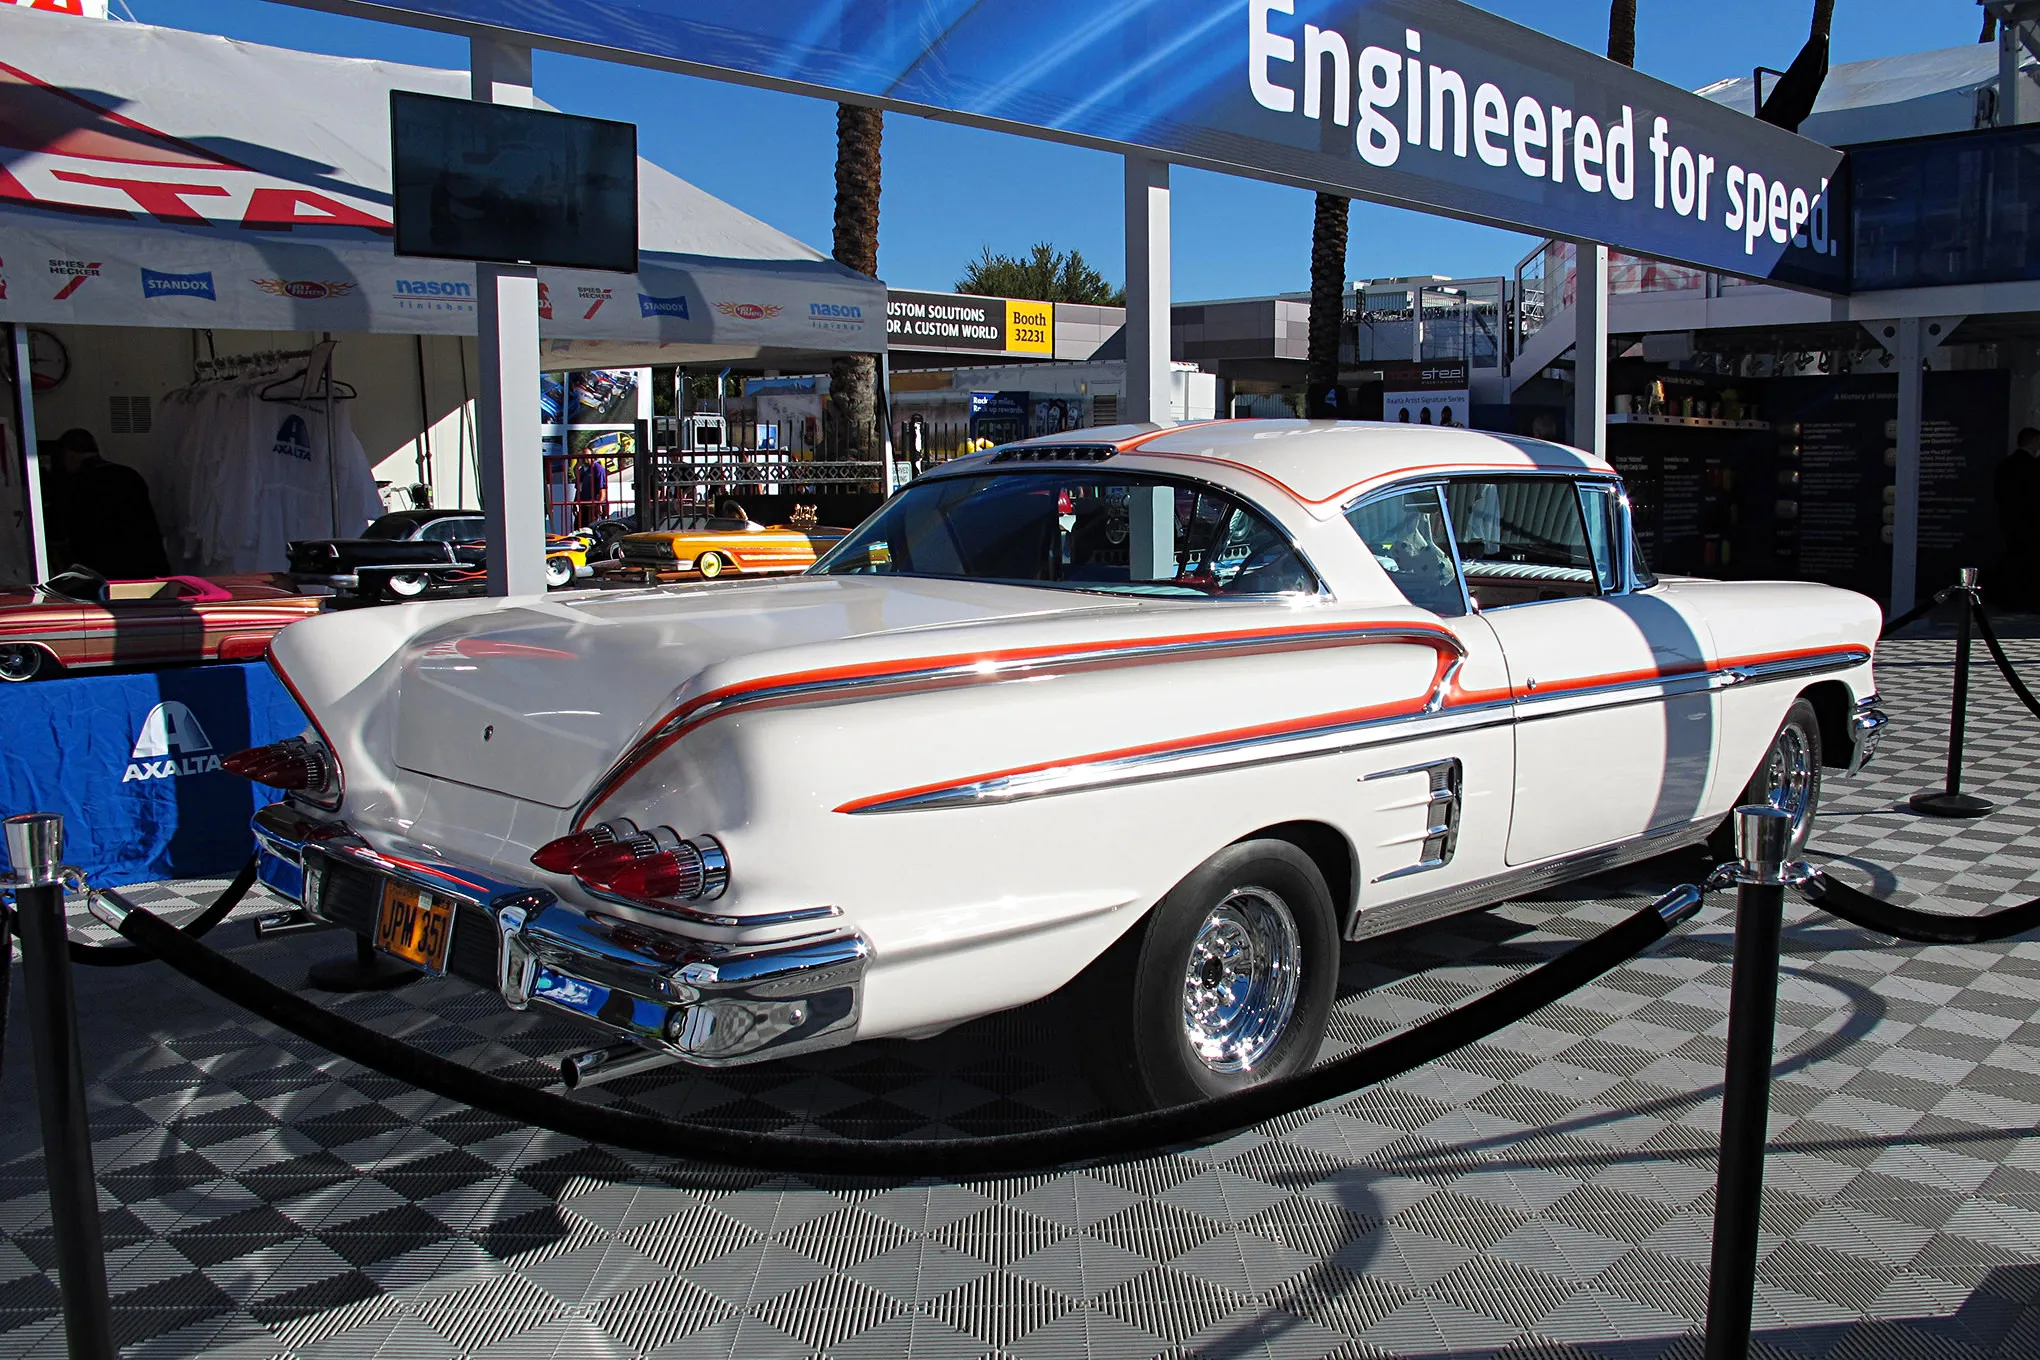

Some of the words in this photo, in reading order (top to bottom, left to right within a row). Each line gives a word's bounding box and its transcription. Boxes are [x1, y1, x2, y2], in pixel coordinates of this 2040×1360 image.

[1249, 0, 1635, 200] Engineered
[1649, 116, 1715, 221] for
[1725, 164, 1837, 257] speed.
[48, 259, 85, 269] SPIES
[49, 267, 100, 277] HECKER
[148, 279, 209, 290] STANDOX
[396, 279, 471, 297] nason
[577, 286, 601, 294] SPIES
[399, 301, 473, 311] finishes
[643, 302, 684, 312] STANDOX
[810, 303, 861, 318] nason
[928, 305, 985, 322] SOLUTIONS
[1013, 311, 1046, 326] Booth
[904, 321, 913, 334] A
[914, 321, 959, 337] CUSTOM
[962, 325, 998, 340] WORLD
[1015, 328, 1045, 343] 32231
[1421, 396, 1446, 405] Signature
[272, 443, 312, 462] AXALTA
[122, 754, 224, 783] AXALTA
[383, 899, 418, 948] JPM
[418, 910, 447, 959] 351
